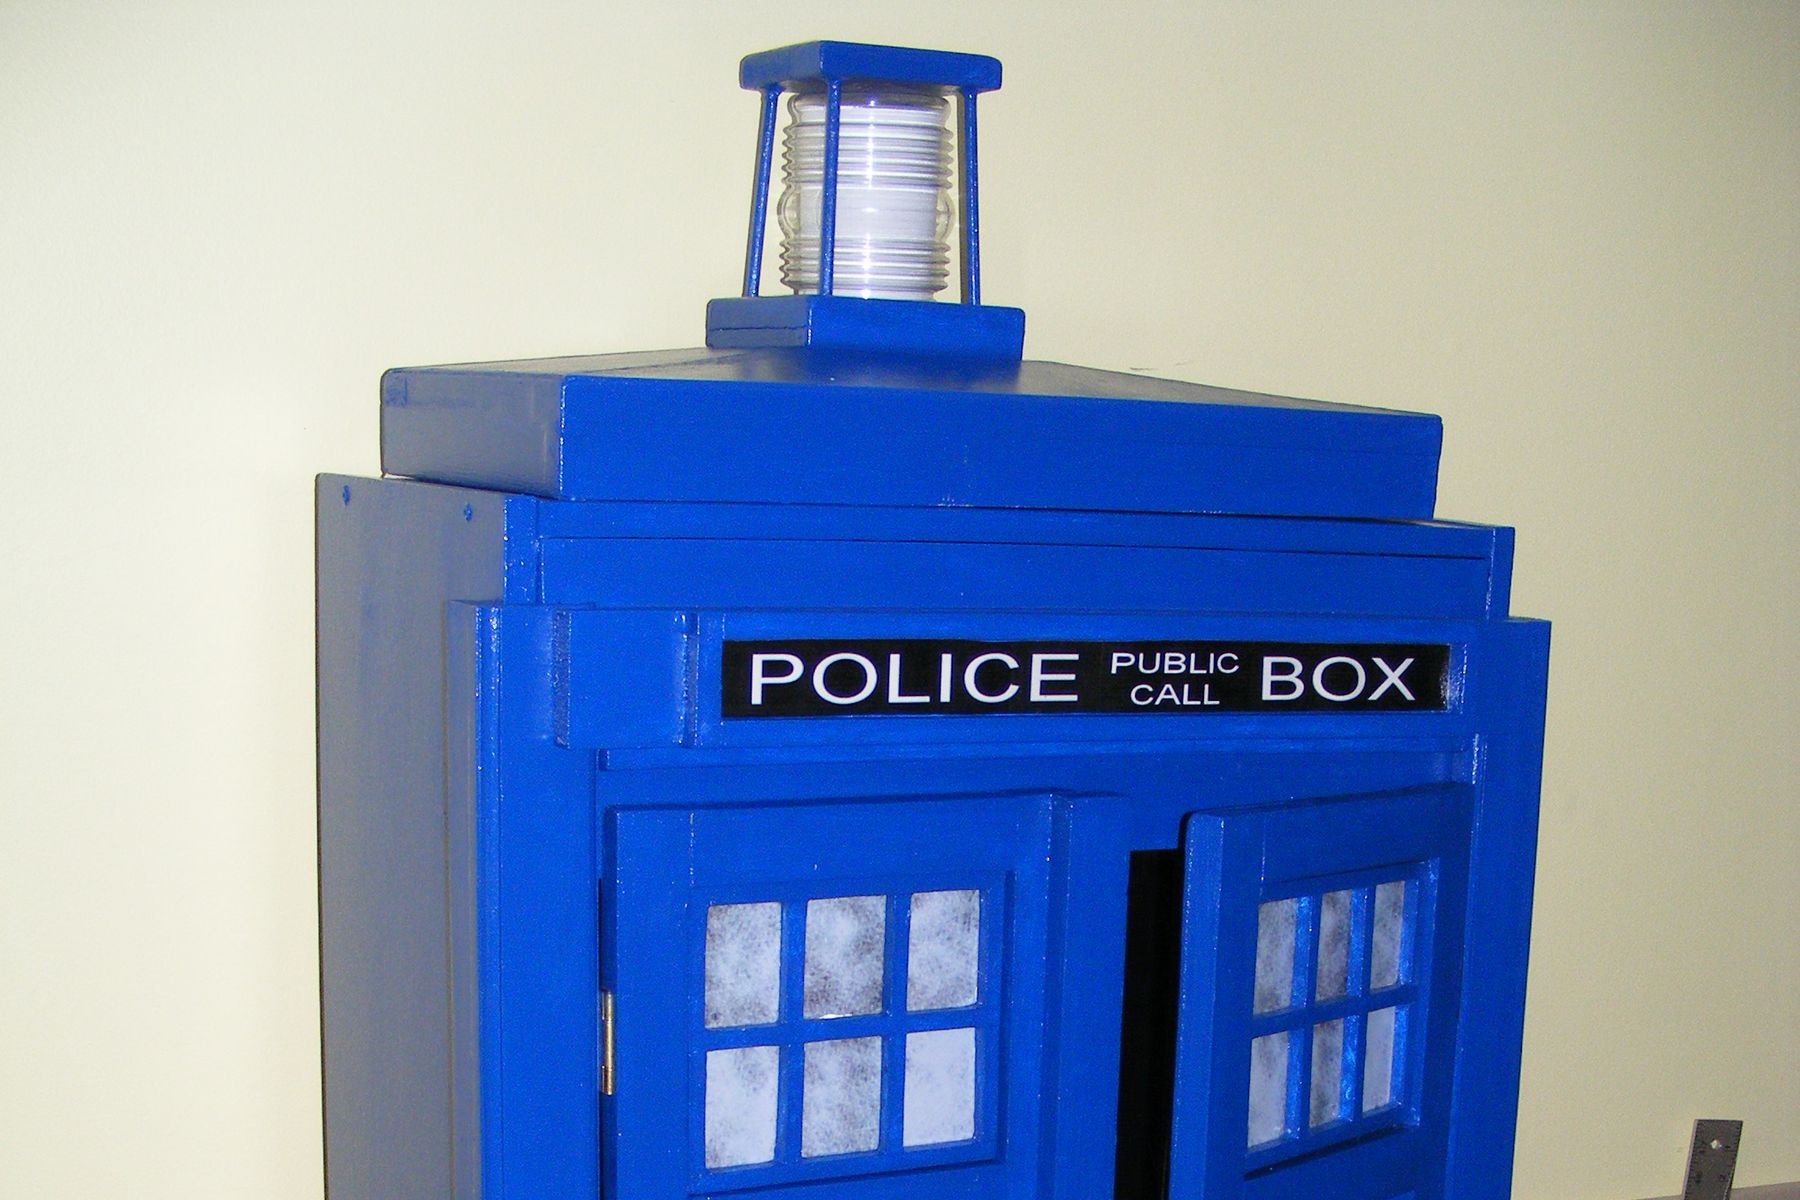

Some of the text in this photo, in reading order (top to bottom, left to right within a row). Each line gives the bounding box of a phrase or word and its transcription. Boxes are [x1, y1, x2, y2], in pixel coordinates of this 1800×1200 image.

[750, 651, 1417, 706] POLICE PUBLIC CALL BOX
